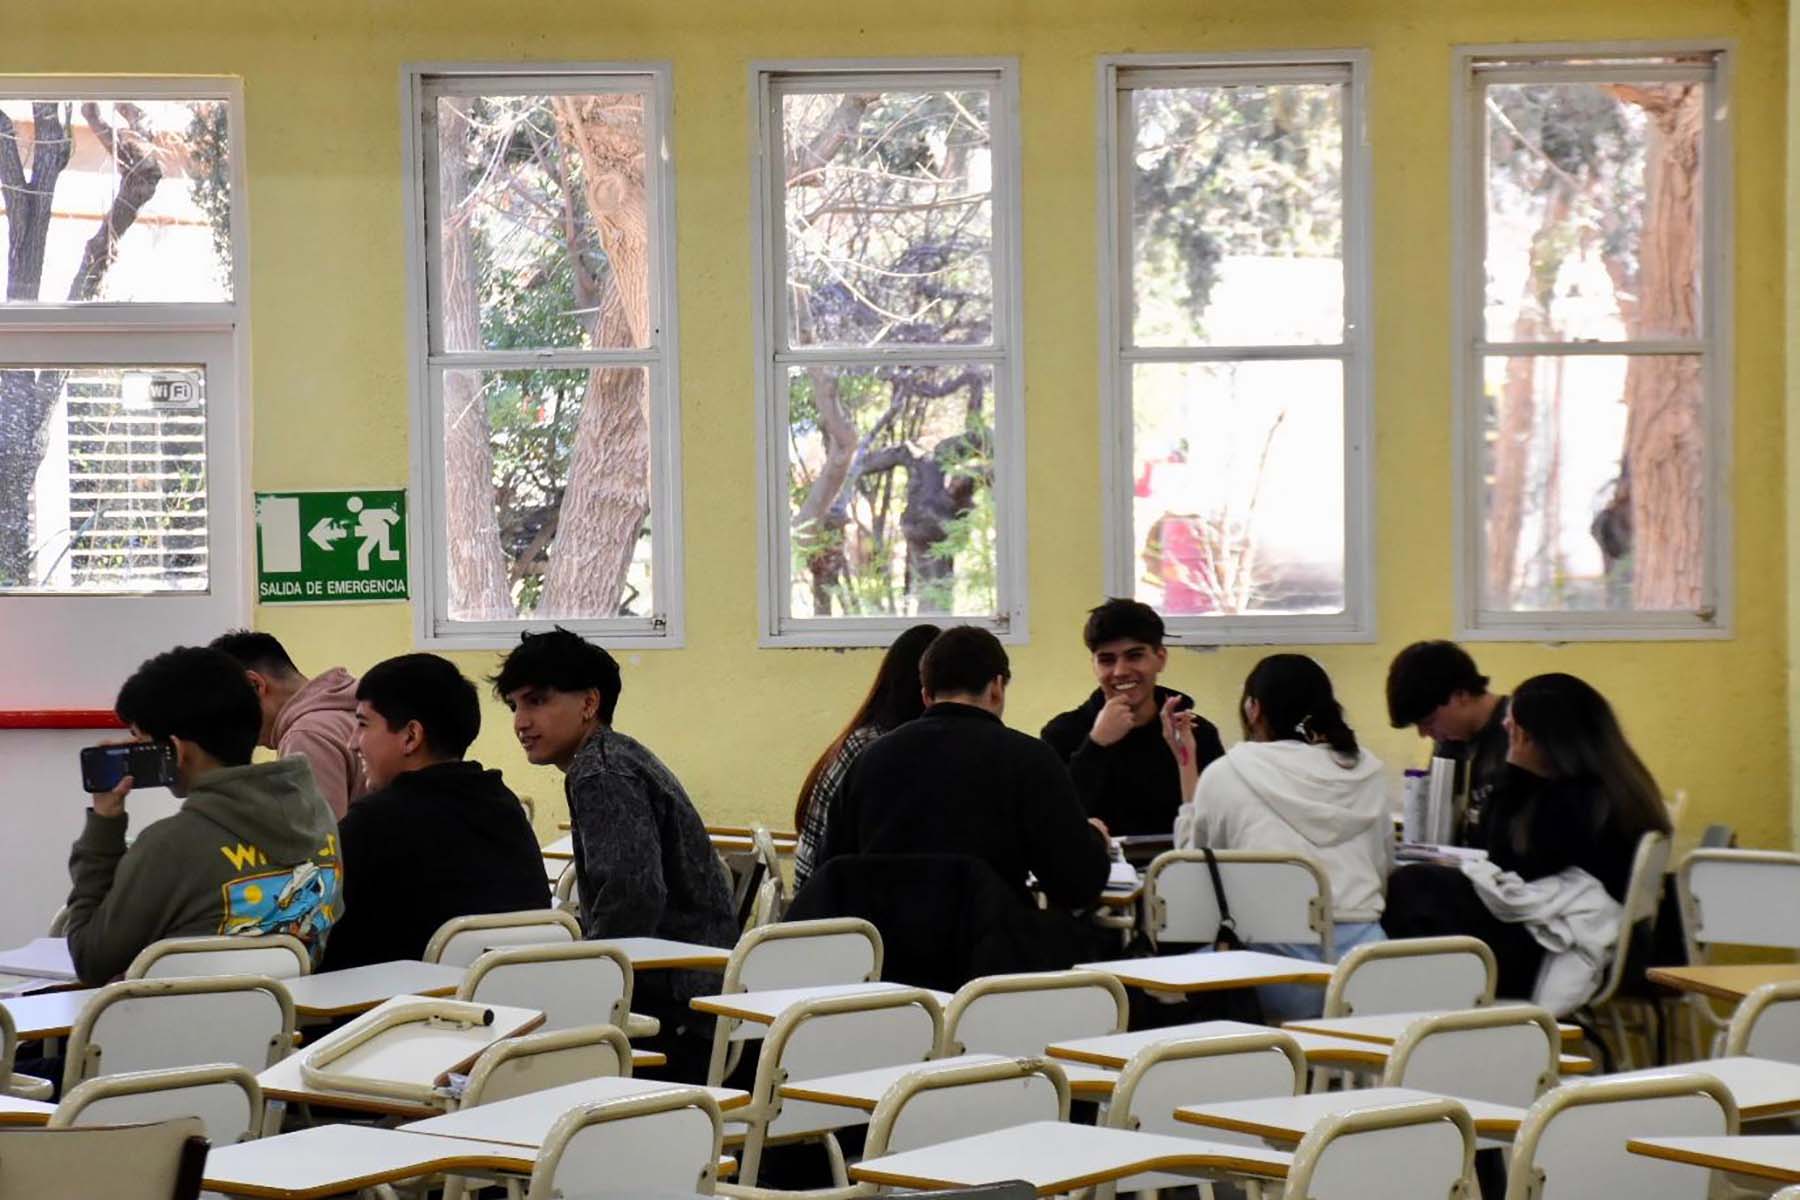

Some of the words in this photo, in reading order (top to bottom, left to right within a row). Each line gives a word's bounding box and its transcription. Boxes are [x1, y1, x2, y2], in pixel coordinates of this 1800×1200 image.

[260, 581, 302, 596] SALIDA
[306, 581, 323, 595] DE
[327, 579, 406, 595] EMERGENCIA
